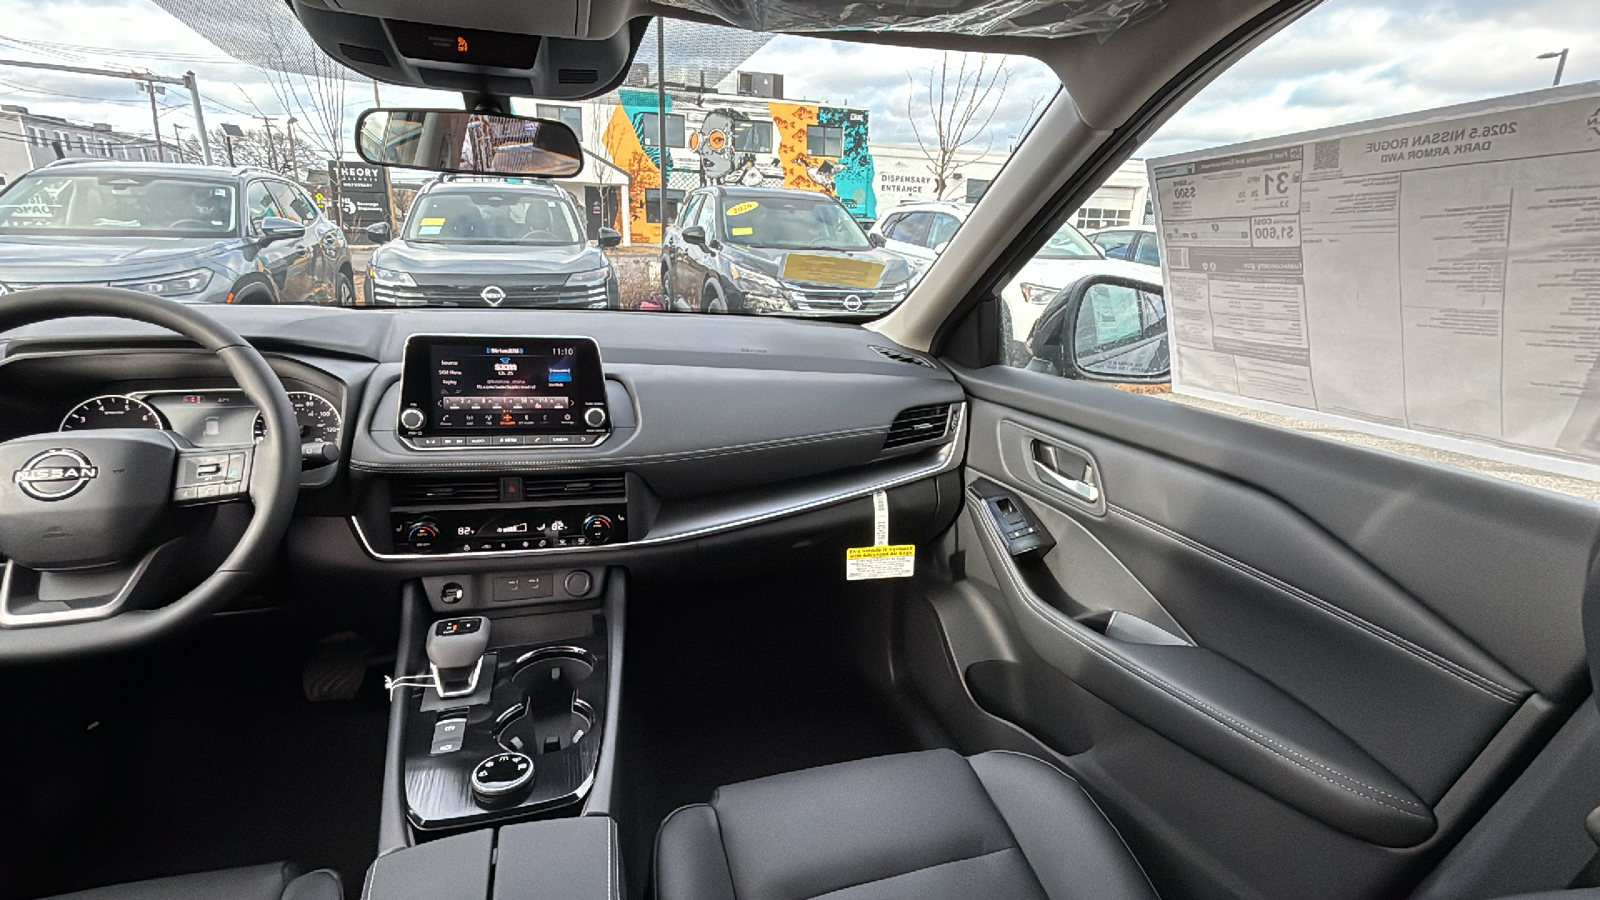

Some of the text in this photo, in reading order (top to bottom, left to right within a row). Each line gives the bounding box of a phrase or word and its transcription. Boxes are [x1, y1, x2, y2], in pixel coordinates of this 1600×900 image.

[333, 168, 378, 177] THEORY
[882, 174, 930, 184] DISPENSARY
[882, 185, 922, 193] ENTRANCE
[16, 468, 96, 481] NISSAN
